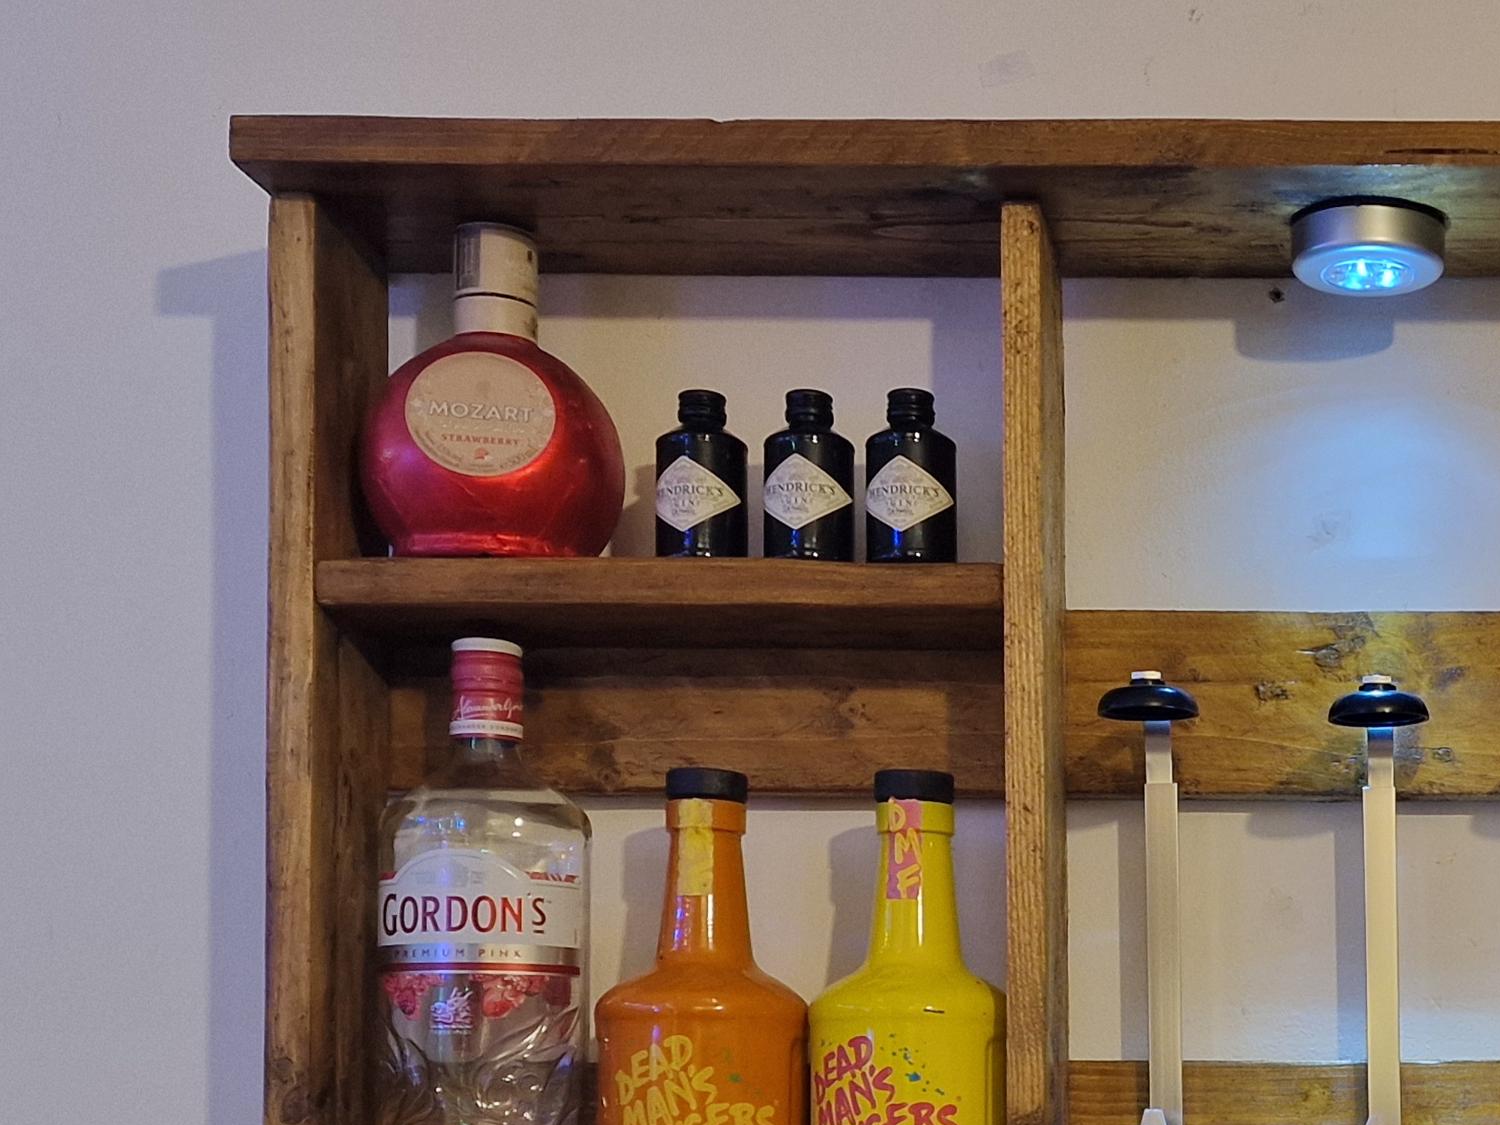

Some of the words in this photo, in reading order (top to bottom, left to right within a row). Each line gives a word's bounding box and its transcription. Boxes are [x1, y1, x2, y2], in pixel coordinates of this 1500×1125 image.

[429, 401, 533, 422] MOZART
[441, 433, 520, 446] STRAWBERRY
[383, 892, 547, 936] GORDON'S
[393, 948, 465, 958] PREMIUM
[478, 949, 521, 958] PINK
[615, 1034, 693, 1106] DEAD
[815, 1035, 873, 1106] DEAD
